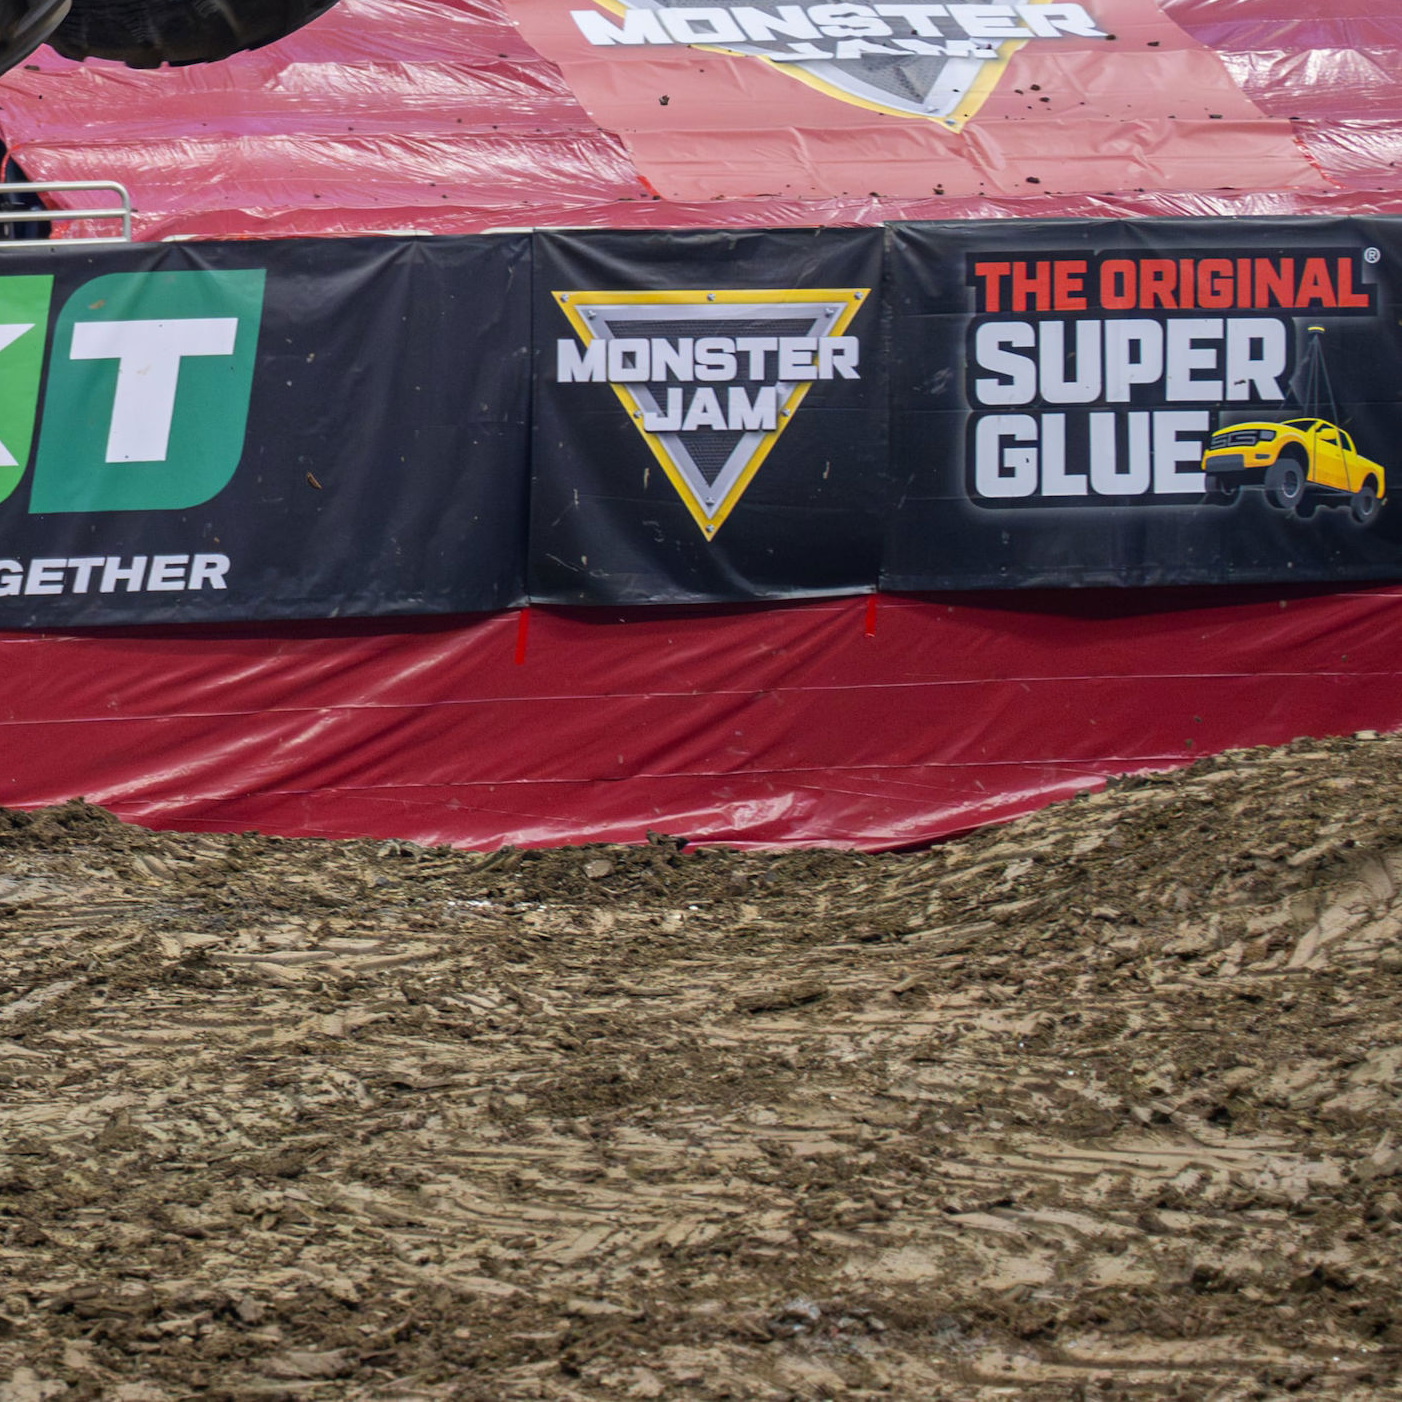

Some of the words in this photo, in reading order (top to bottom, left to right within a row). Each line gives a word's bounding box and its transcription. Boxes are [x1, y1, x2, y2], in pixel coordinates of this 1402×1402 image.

[570, 2, 1111, 46] MONSTER
[975, 260, 1087, 313] THE
[557, 334, 861, 383] MONSTER
[975, 317, 1286, 406] SUPER
[644, 386, 777, 432] JAM
[975, 410, 1209, 498] GLUE
